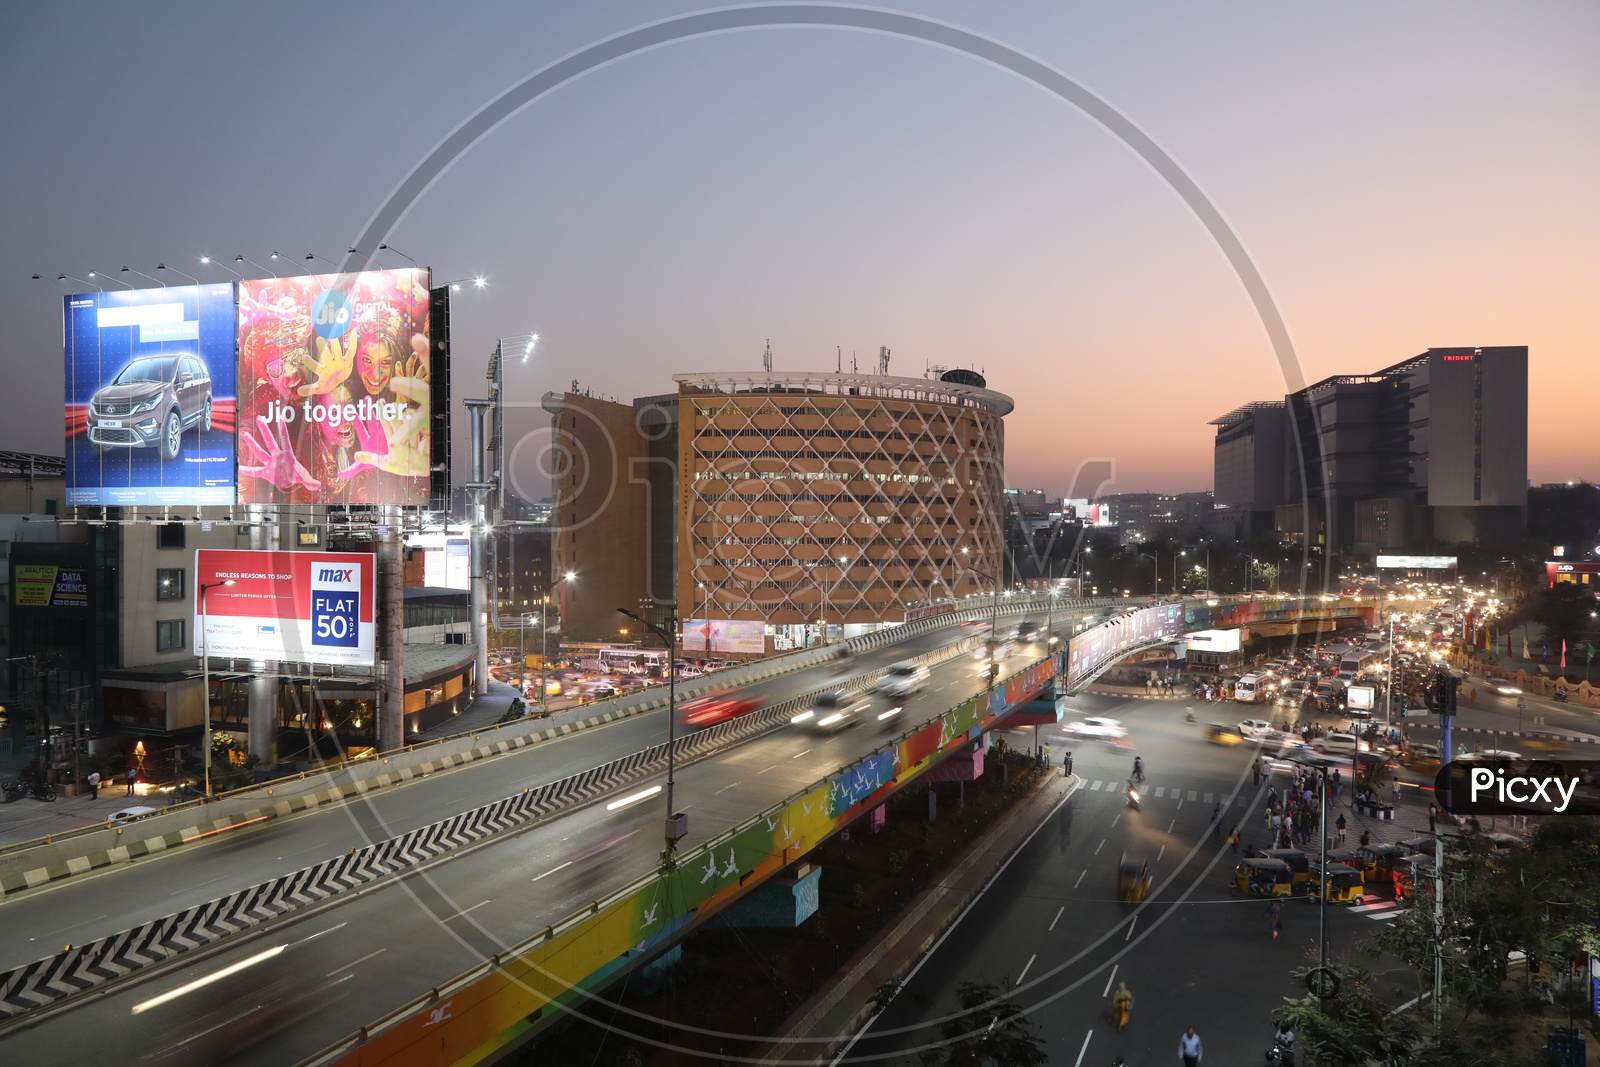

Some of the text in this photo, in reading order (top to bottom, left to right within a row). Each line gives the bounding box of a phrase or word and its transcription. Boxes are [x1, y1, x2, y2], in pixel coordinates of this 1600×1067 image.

[316, 302, 348, 325] Jio
[356, 302, 392, 312] DIGITAL
[356, 314, 376, 322] LIFE
[262, 398, 412, 427] Jio together.
[62, 573, 81, 582] DATA
[318, 569, 353, 583] max
[56, 584, 87, 592] SCIENCE
[316, 598, 354, 612] FLAT
[317, 615, 347, 638] 50
